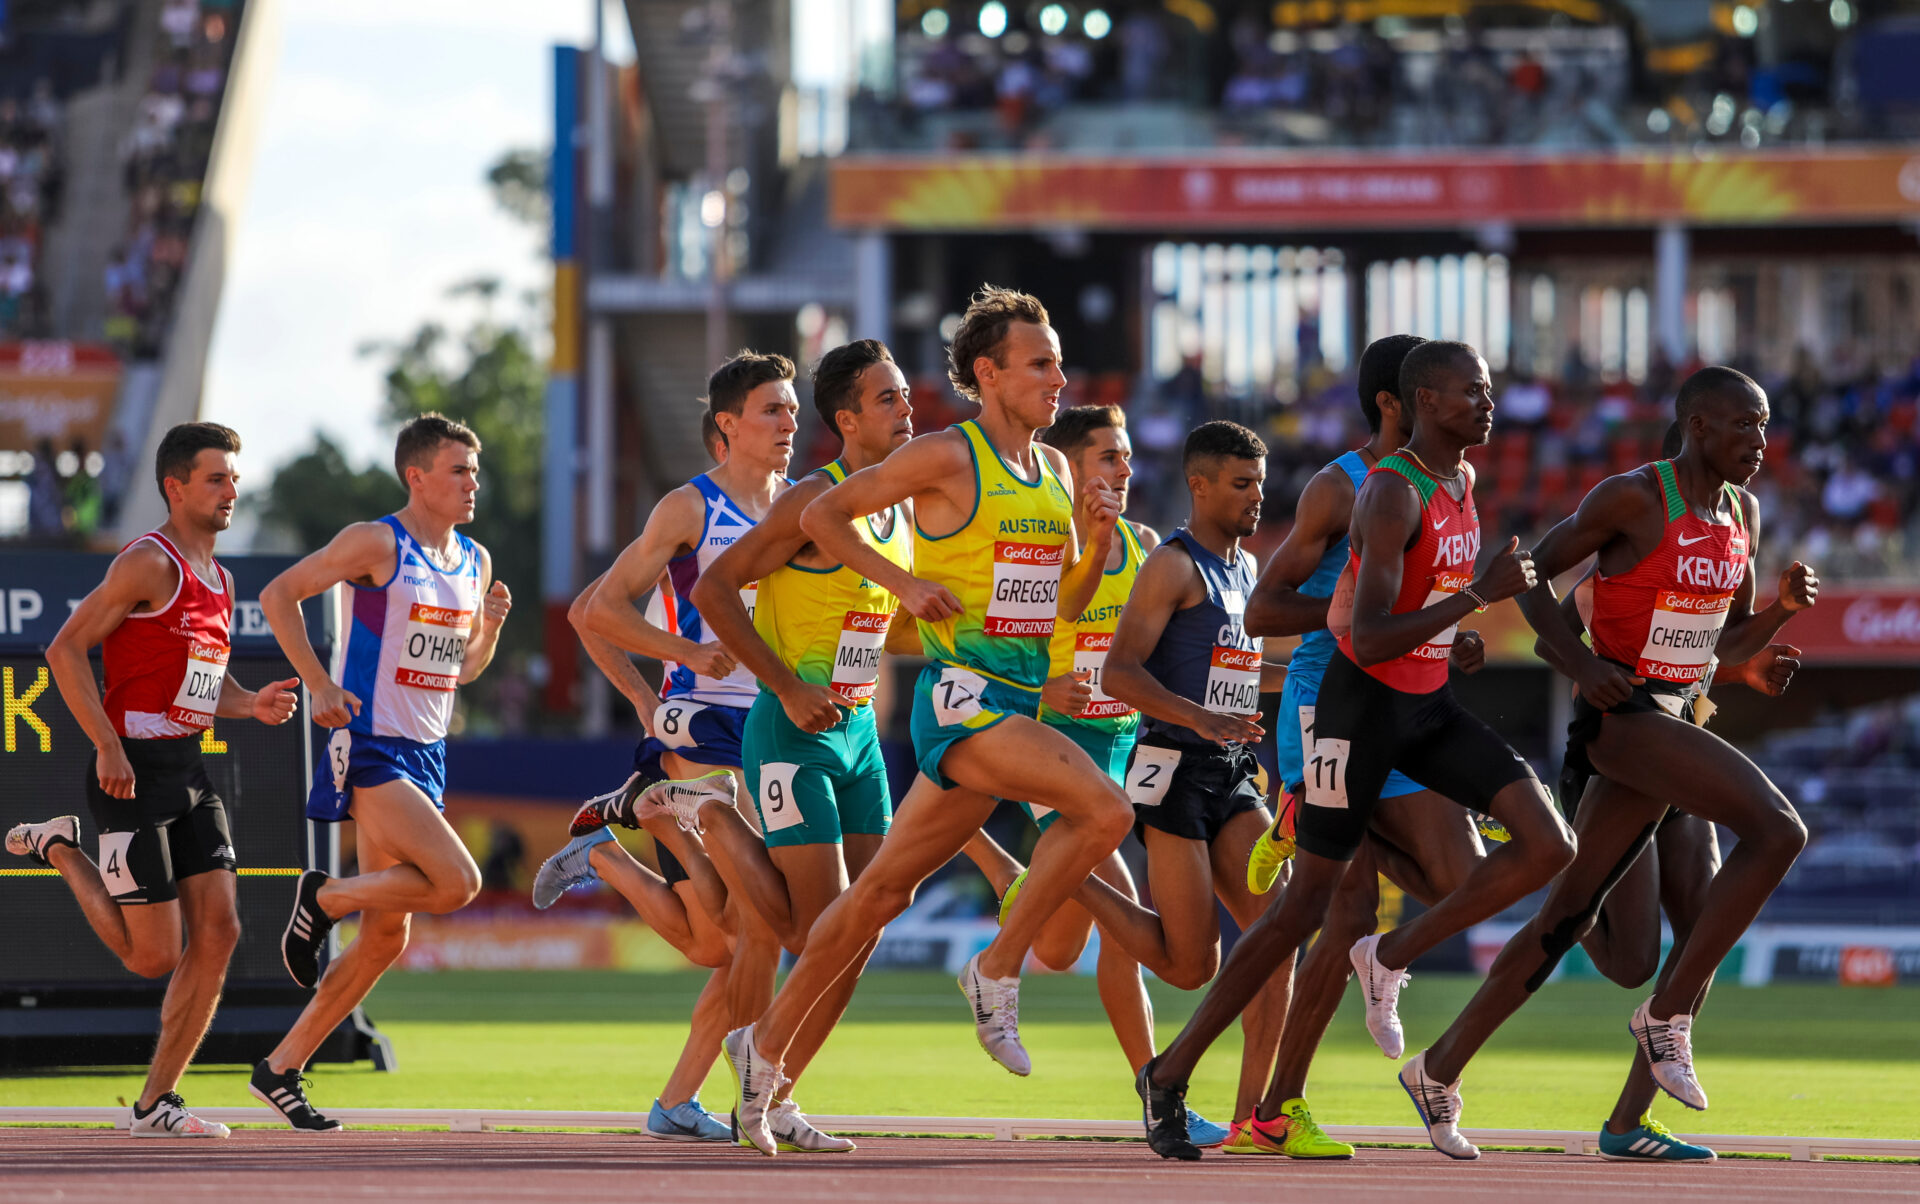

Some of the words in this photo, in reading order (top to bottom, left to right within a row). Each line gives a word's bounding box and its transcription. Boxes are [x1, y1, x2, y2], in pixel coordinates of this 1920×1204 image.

[1003, 545, 1032, 560] Gold
[1034, 548, 1059, 561] Coast
[1442, 575, 1461, 589] Gold
[1676, 555, 1745, 590] KENYA
[996, 578, 1059, 604] GREGSO
[1665, 595, 1694, 609] Gold
[1695, 597, 1719, 610] Coast
[418, 608, 444, 621] Gold
[852, 615, 874, 628] Gold
[995, 620, 1055, 634] LONGINES
[194, 644, 214, 659] Gold
[1084, 635, 1112, 648] Gold
[1220, 652, 1245, 666] Gold
[187, 671, 222, 701] DIXO
[3, 666, 51, 752] K
[663, 707, 683, 735] 8
[335, 746, 345, 776] 3
[1310, 755, 1338, 791] 11
[1138, 764, 1161, 788] 2
[767, 779, 784, 812] 9
[107, 848, 120, 878] 4
